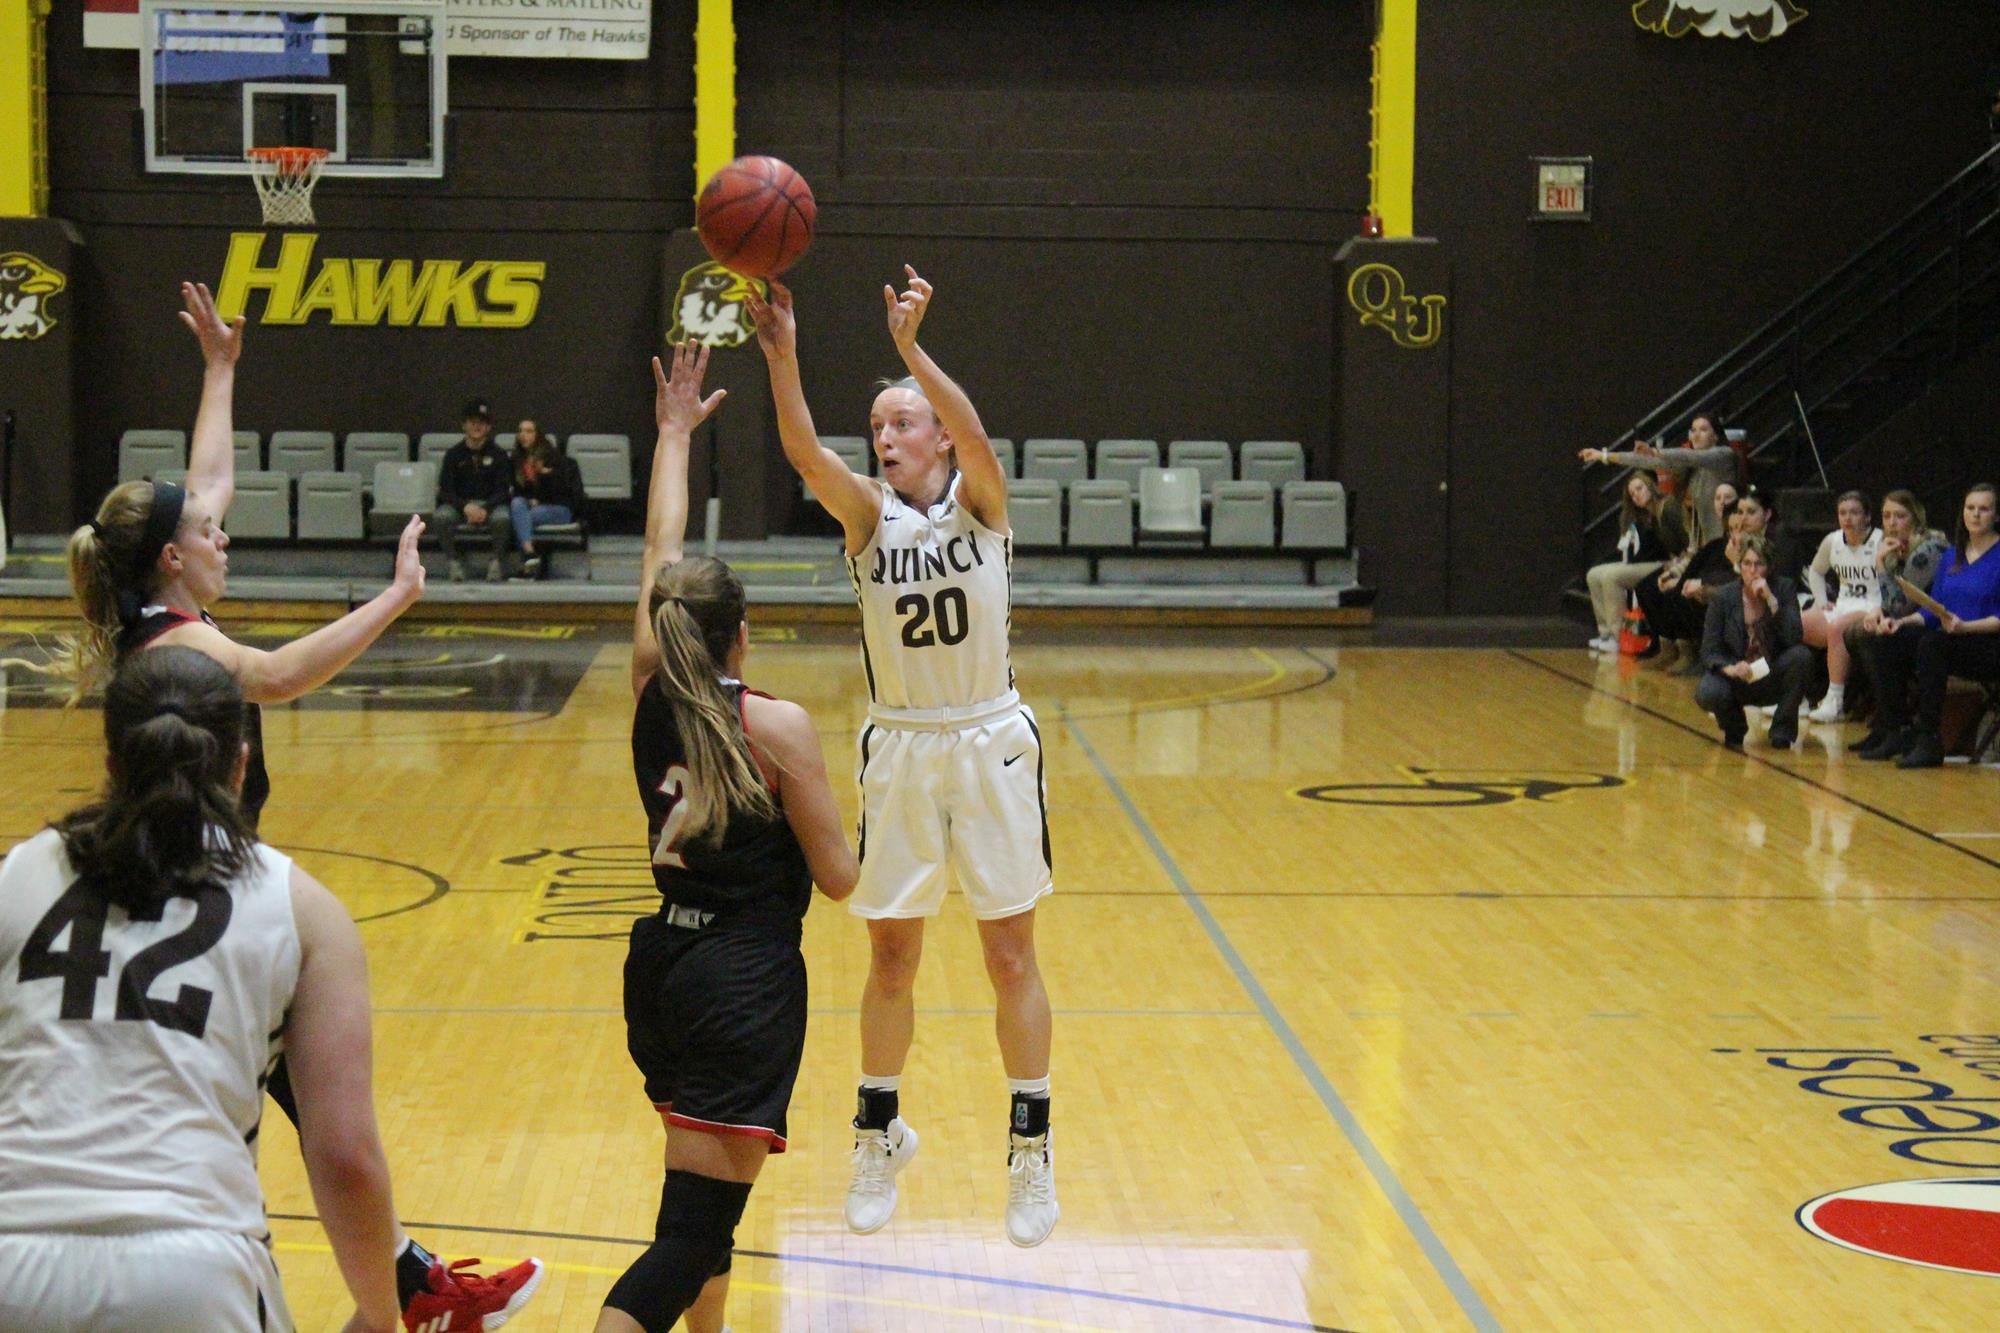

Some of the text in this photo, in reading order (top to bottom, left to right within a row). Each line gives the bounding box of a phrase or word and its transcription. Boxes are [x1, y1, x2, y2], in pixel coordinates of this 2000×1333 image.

[459, 24, 530, 42] Sponsor
[535, 26, 553, 41] of
[558, 26, 586, 41] The
[592, 28, 646, 43] Hawks
[1545, 186, 1577, 209] EXIT
[214, 232, 546, 328] HAWKS
[1347, 262, 1447, 349] QU
[870, 530, 984, 586] QUINCY
[1834, 564, 1877, 580] QUINCY
[895, 587, 969, 648] 20
[17, 873, 233, 1040] 42
